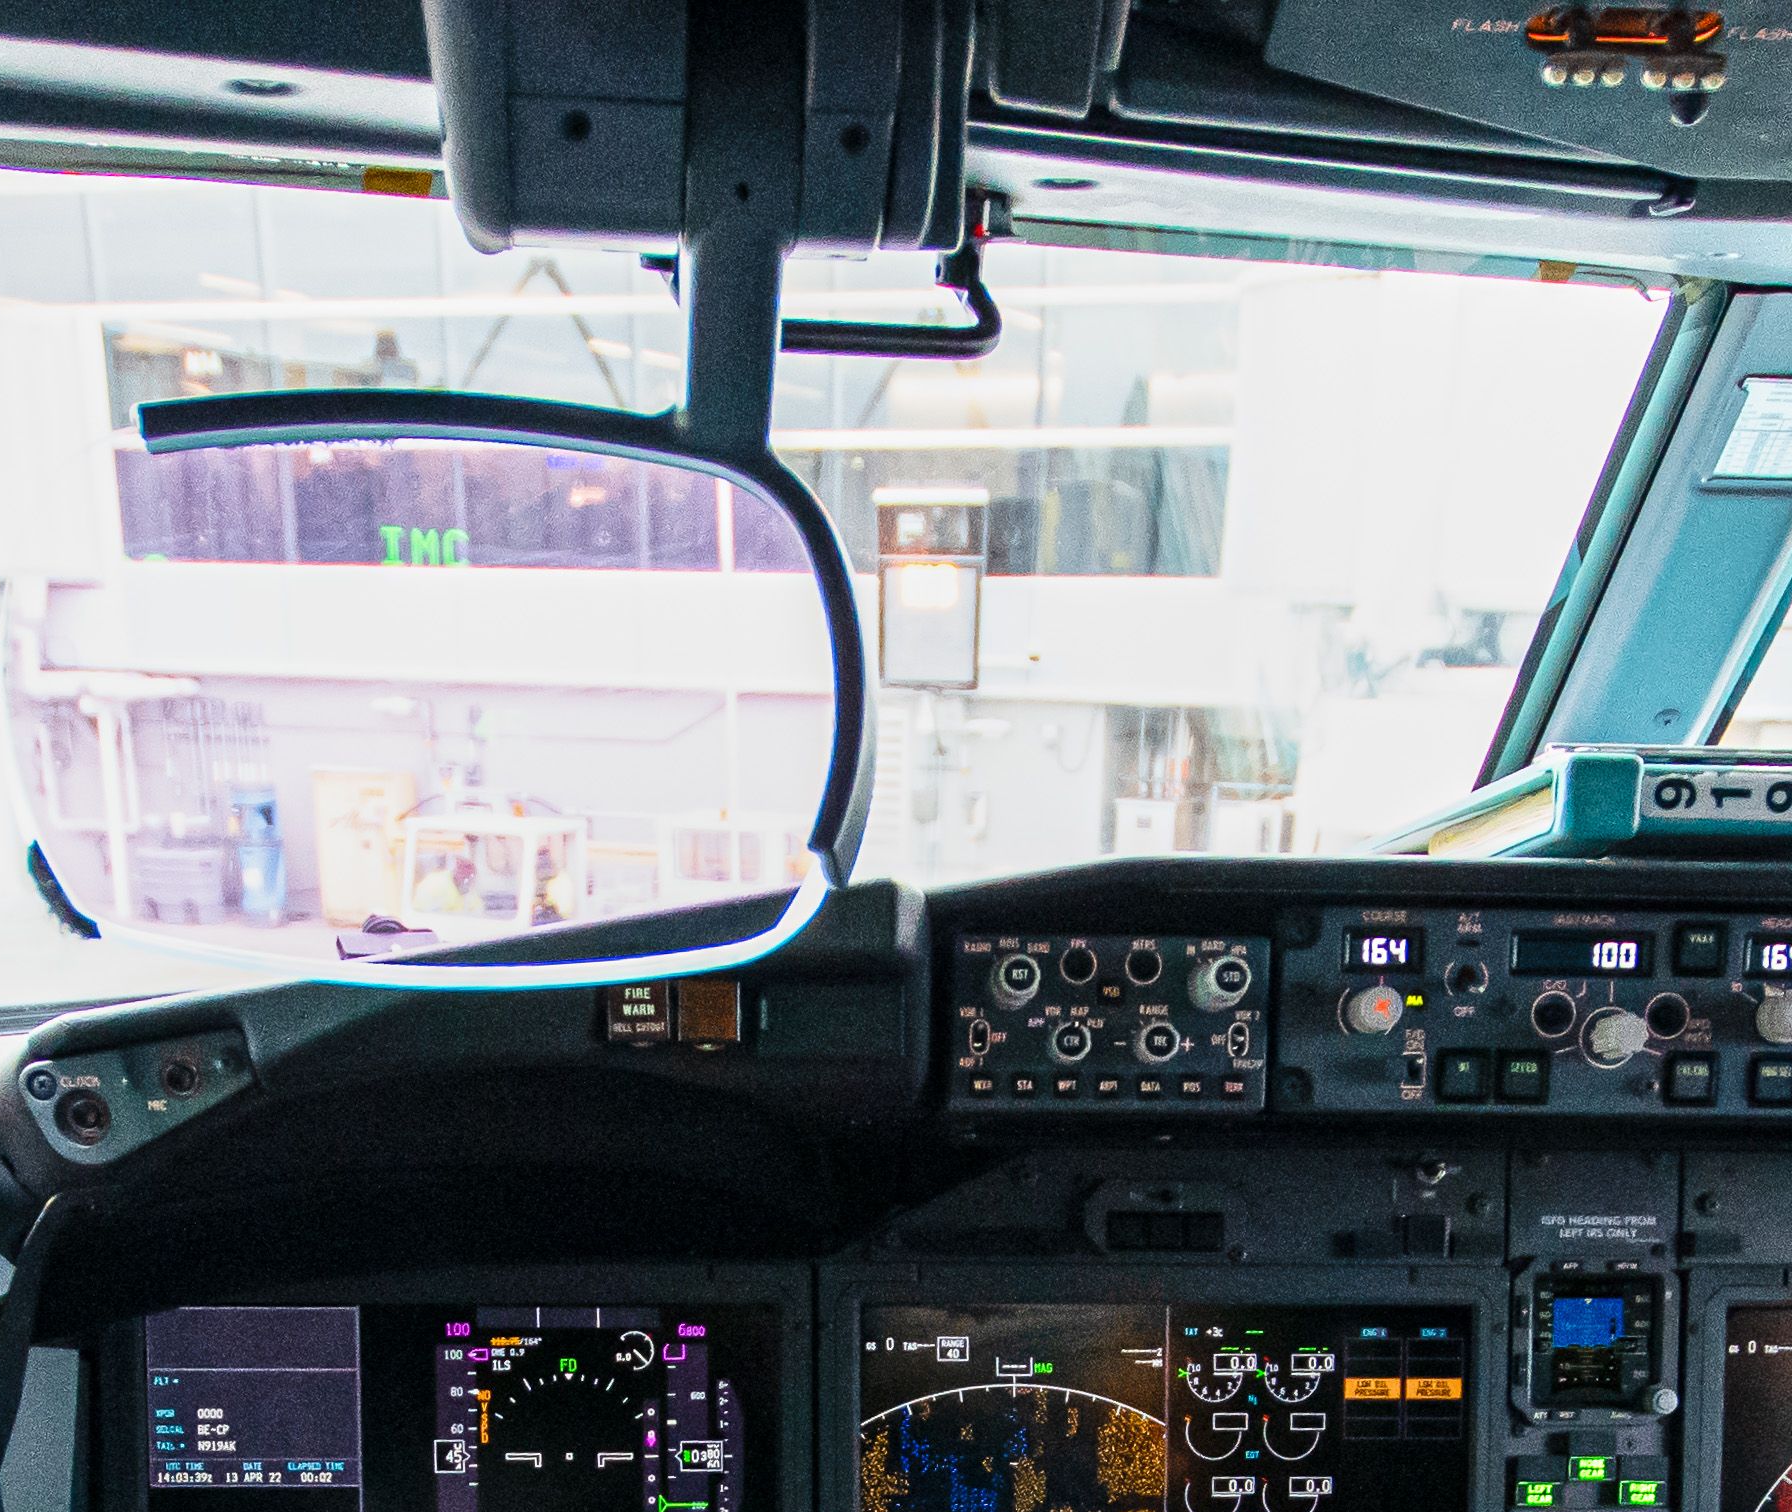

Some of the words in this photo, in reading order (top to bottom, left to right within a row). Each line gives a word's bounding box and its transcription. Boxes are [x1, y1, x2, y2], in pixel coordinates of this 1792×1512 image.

[1361, 938, 1407, 965] 164
[1592, 943, 1637, 969] 100
[625, 988, 650, 999] FIRE
[623, 1004, 655, 1016] WARN
[446, 1323, 470, 1336] 100
[444, 1350, 463, 1360] 100
[493, 1360, 511, 1371] ILS
[560, 1359, 577, 1371] FD
[1230, 1357, 1256, 1369] 0.0
[1309, 1356, 1333, 1369] 0.0
[450, 1387, 463, 1397] 80
[451, 1424, 463, 1433] 60
[226, 1473, 238, 1483] 13
[244, 1473, 263, 1483] APR
[269, 1473, 282, 1483] 22
[1229, 1479, 1253, 1492] 0.0
[1307, 1479, 1330, 1492] 0.0
[1528, 1485, 1552, 1493] LEFT
